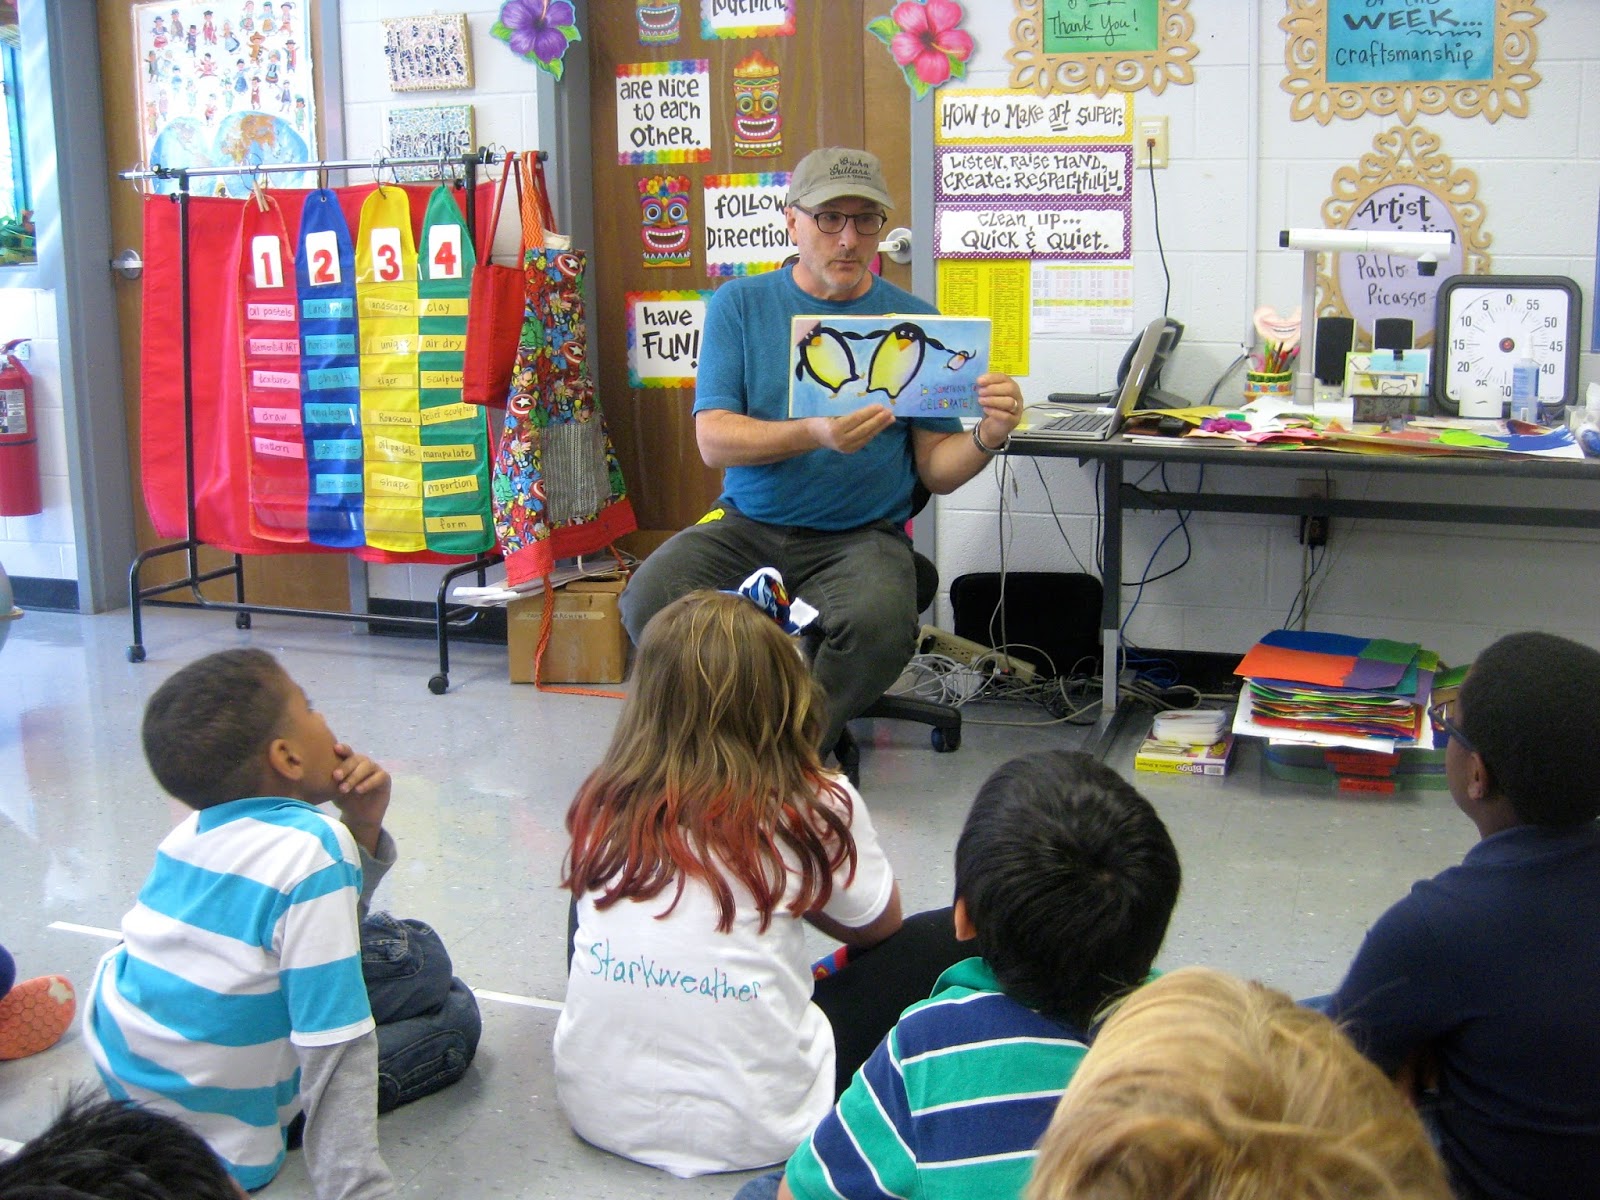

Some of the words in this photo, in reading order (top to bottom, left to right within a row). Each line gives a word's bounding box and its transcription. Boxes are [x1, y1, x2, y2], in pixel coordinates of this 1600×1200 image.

[1048, 11, 1093, 35] Thank
[982, 105, 1000, 128] to
[1357, 193, 1431, 223] Artist
[377, 244, 400, 281] 3
[434, 241, 457, 276] 4
[261, 252, 274, 285] 1
[312, 249, 335, 283] 2
[1356, 254, 1407, 280] Pablo
[1368, 282, 1430, 307] Picasso
[1506, 294, 1513, 305] 0
[427, 302, 450, 315] clay
[1482, 300, 1489, 310] 5
[1526, 299, 1540, 310] 55
[643, 306, 692, 327] have
[1460, 316, 1472, 327] 10
[1544, 316, 1557, 328] 50
[425, 339, 438, 348] air
[443, 338, 462, 350] dry
[1453, 339, 1465, 350] 15
[1549, 341, 1563, 352] 45
[1457, 361, 1470, 373] 20
[1541, 363, 1555, 374] 40
[427, 375, 464, 385] sculptur
[262, 410, 288, 421] draw
[260, 442, 290, 454] pattern
[422, 448, 473, 460] manipulate
[380, 478, 410, 490] shape
[438, 517, 467, 530] form
[1176, 763, 1203, 773] Bingo
[590, 938, 761, 1003] Starkweather
